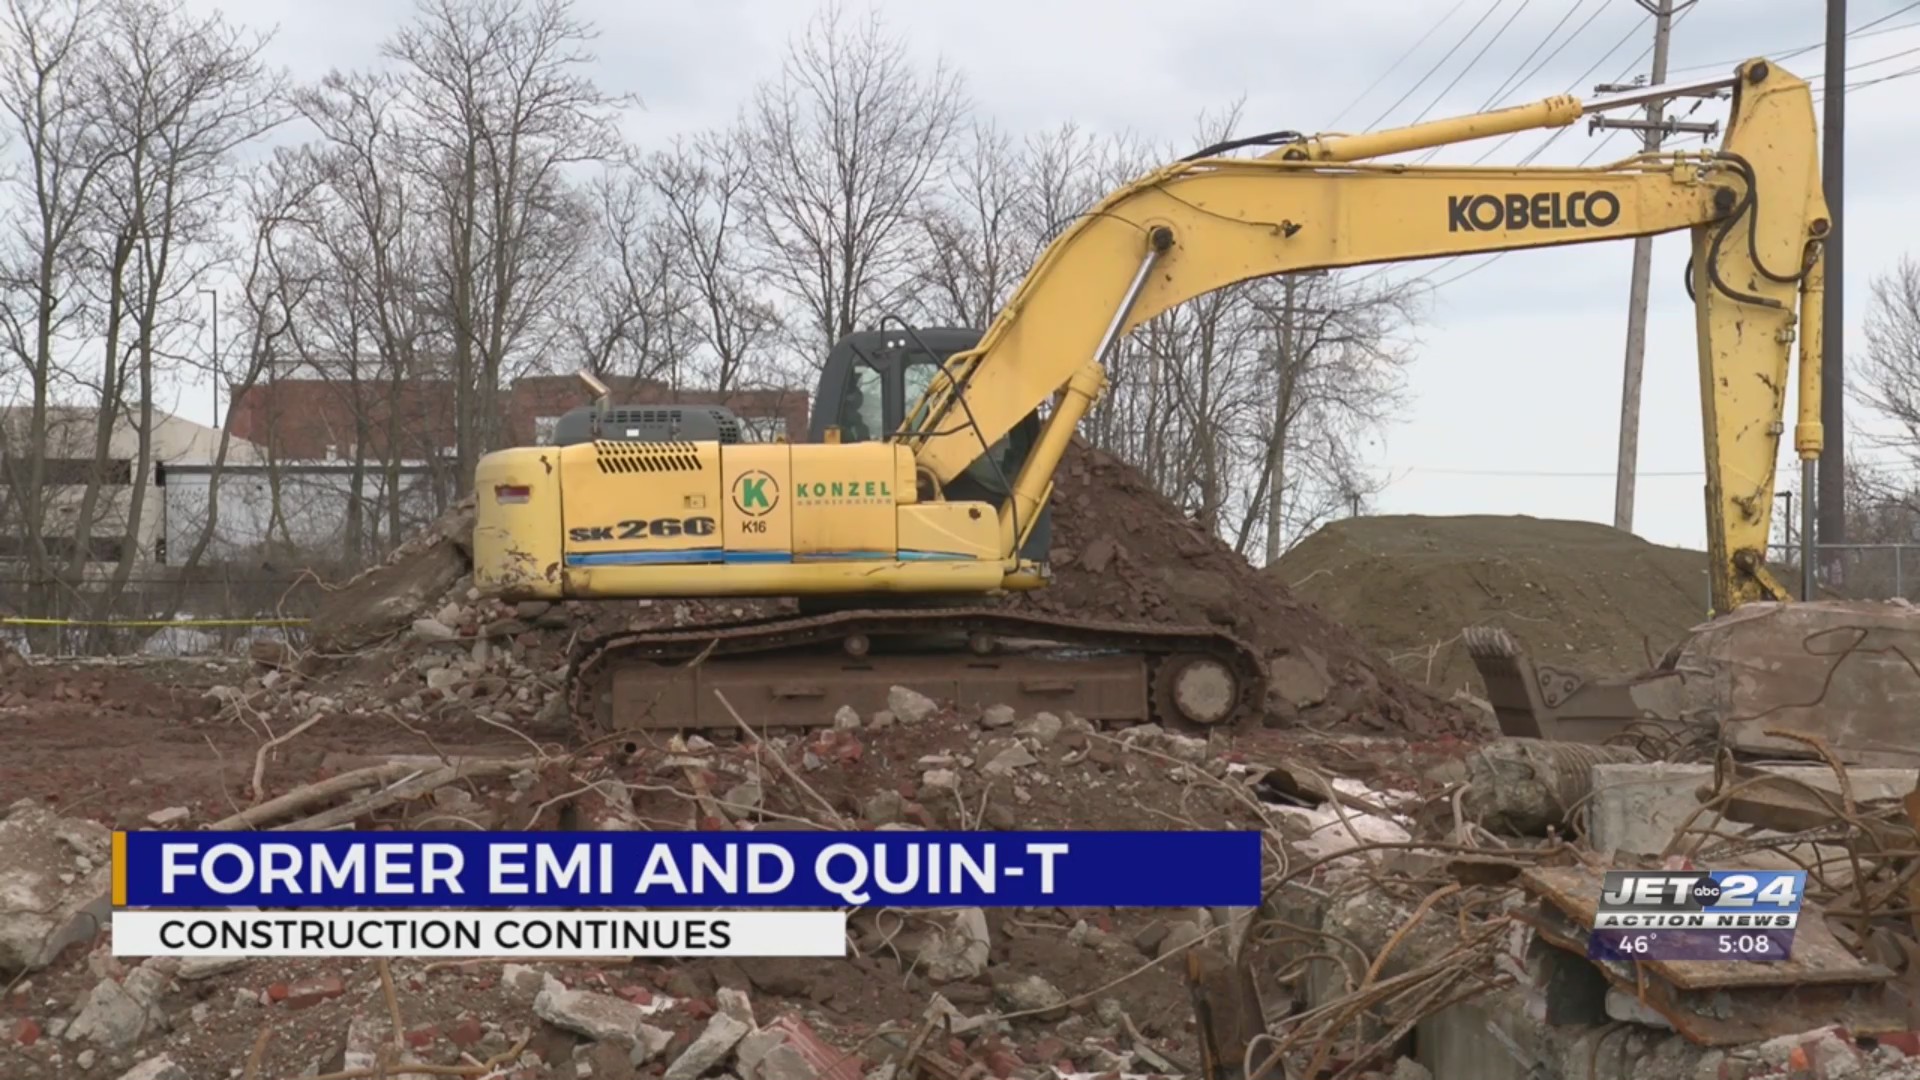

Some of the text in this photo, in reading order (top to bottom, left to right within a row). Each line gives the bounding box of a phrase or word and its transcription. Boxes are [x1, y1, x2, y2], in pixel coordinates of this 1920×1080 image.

[1448, 190, 1620, 232] KOBELCO
[743, 478, 769, 508] K
[797, 482, 891, 497] KONZEL
[742, 521, 767, 533] K16
